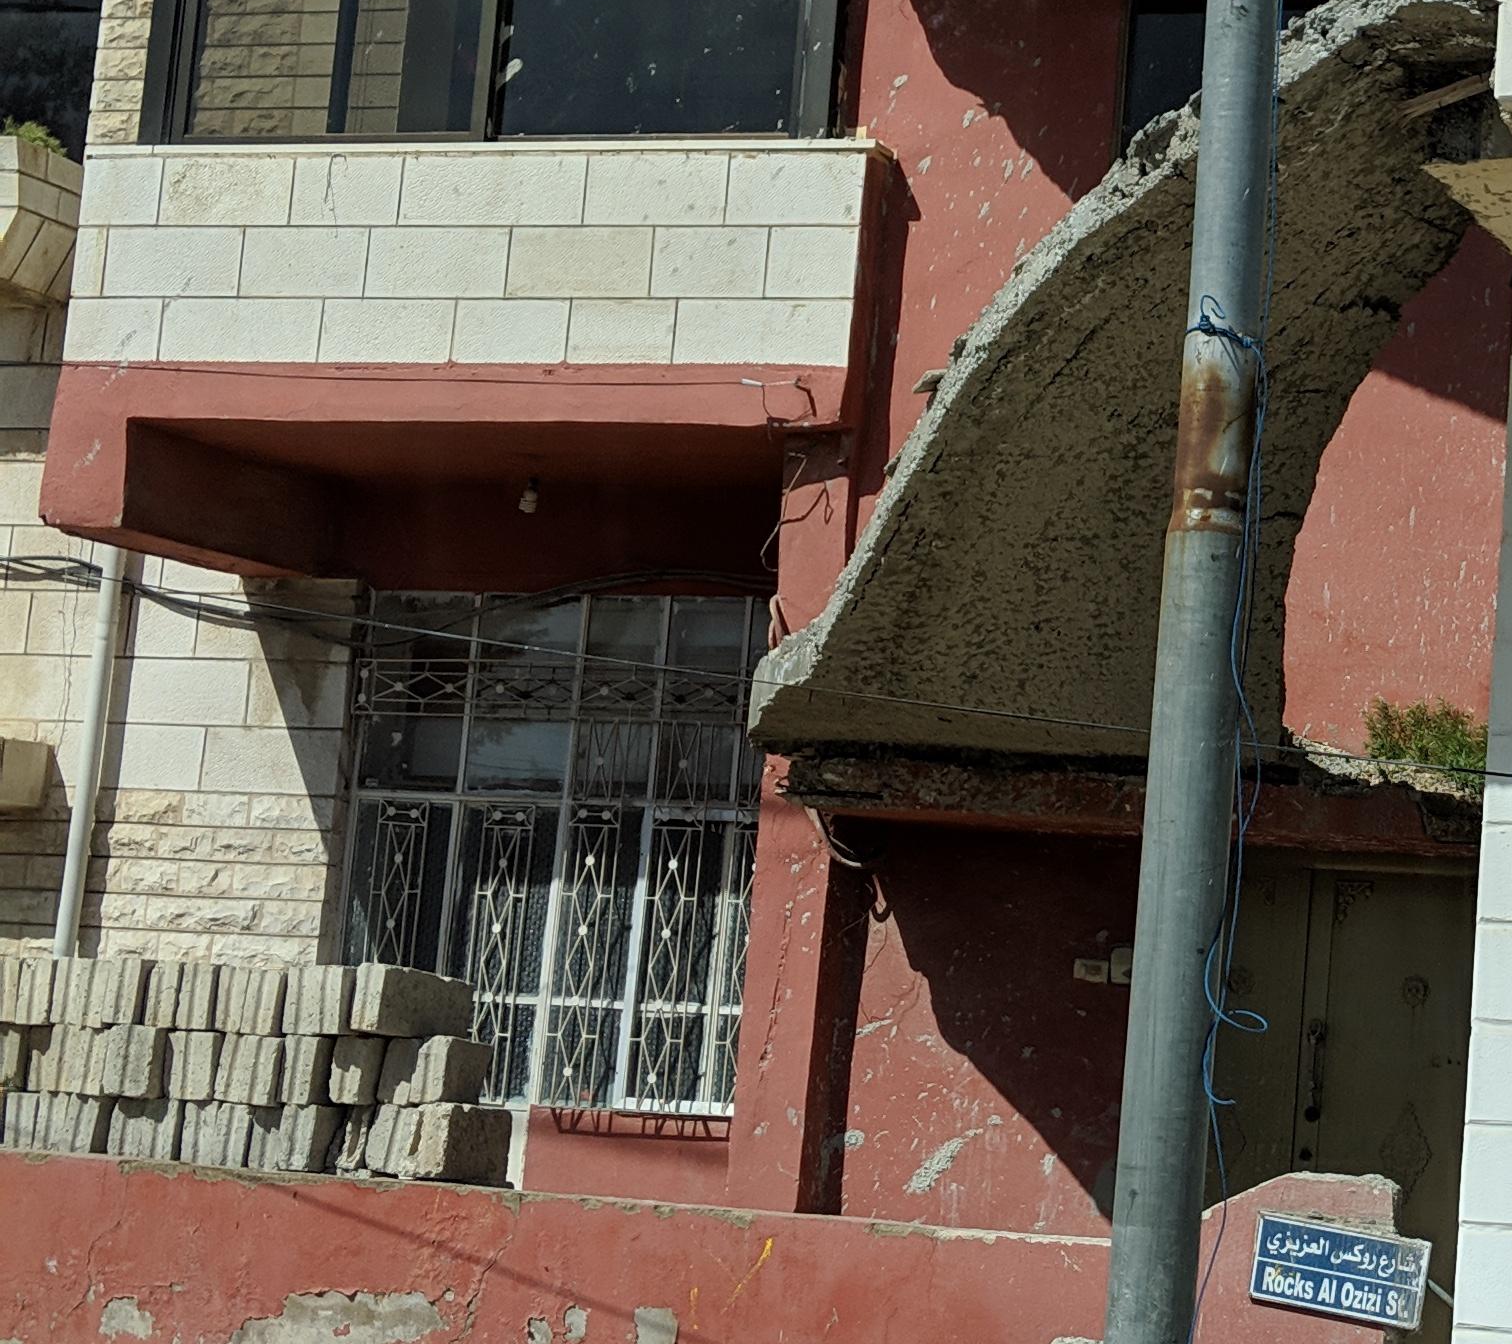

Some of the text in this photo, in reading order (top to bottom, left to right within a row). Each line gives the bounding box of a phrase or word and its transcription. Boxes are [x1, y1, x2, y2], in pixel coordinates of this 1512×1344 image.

[1266, 1231, 1416, 1278] شارع روكس العزيزي
[1261, 1265, 1409, 1319] Rocks Al Ozizi St.
